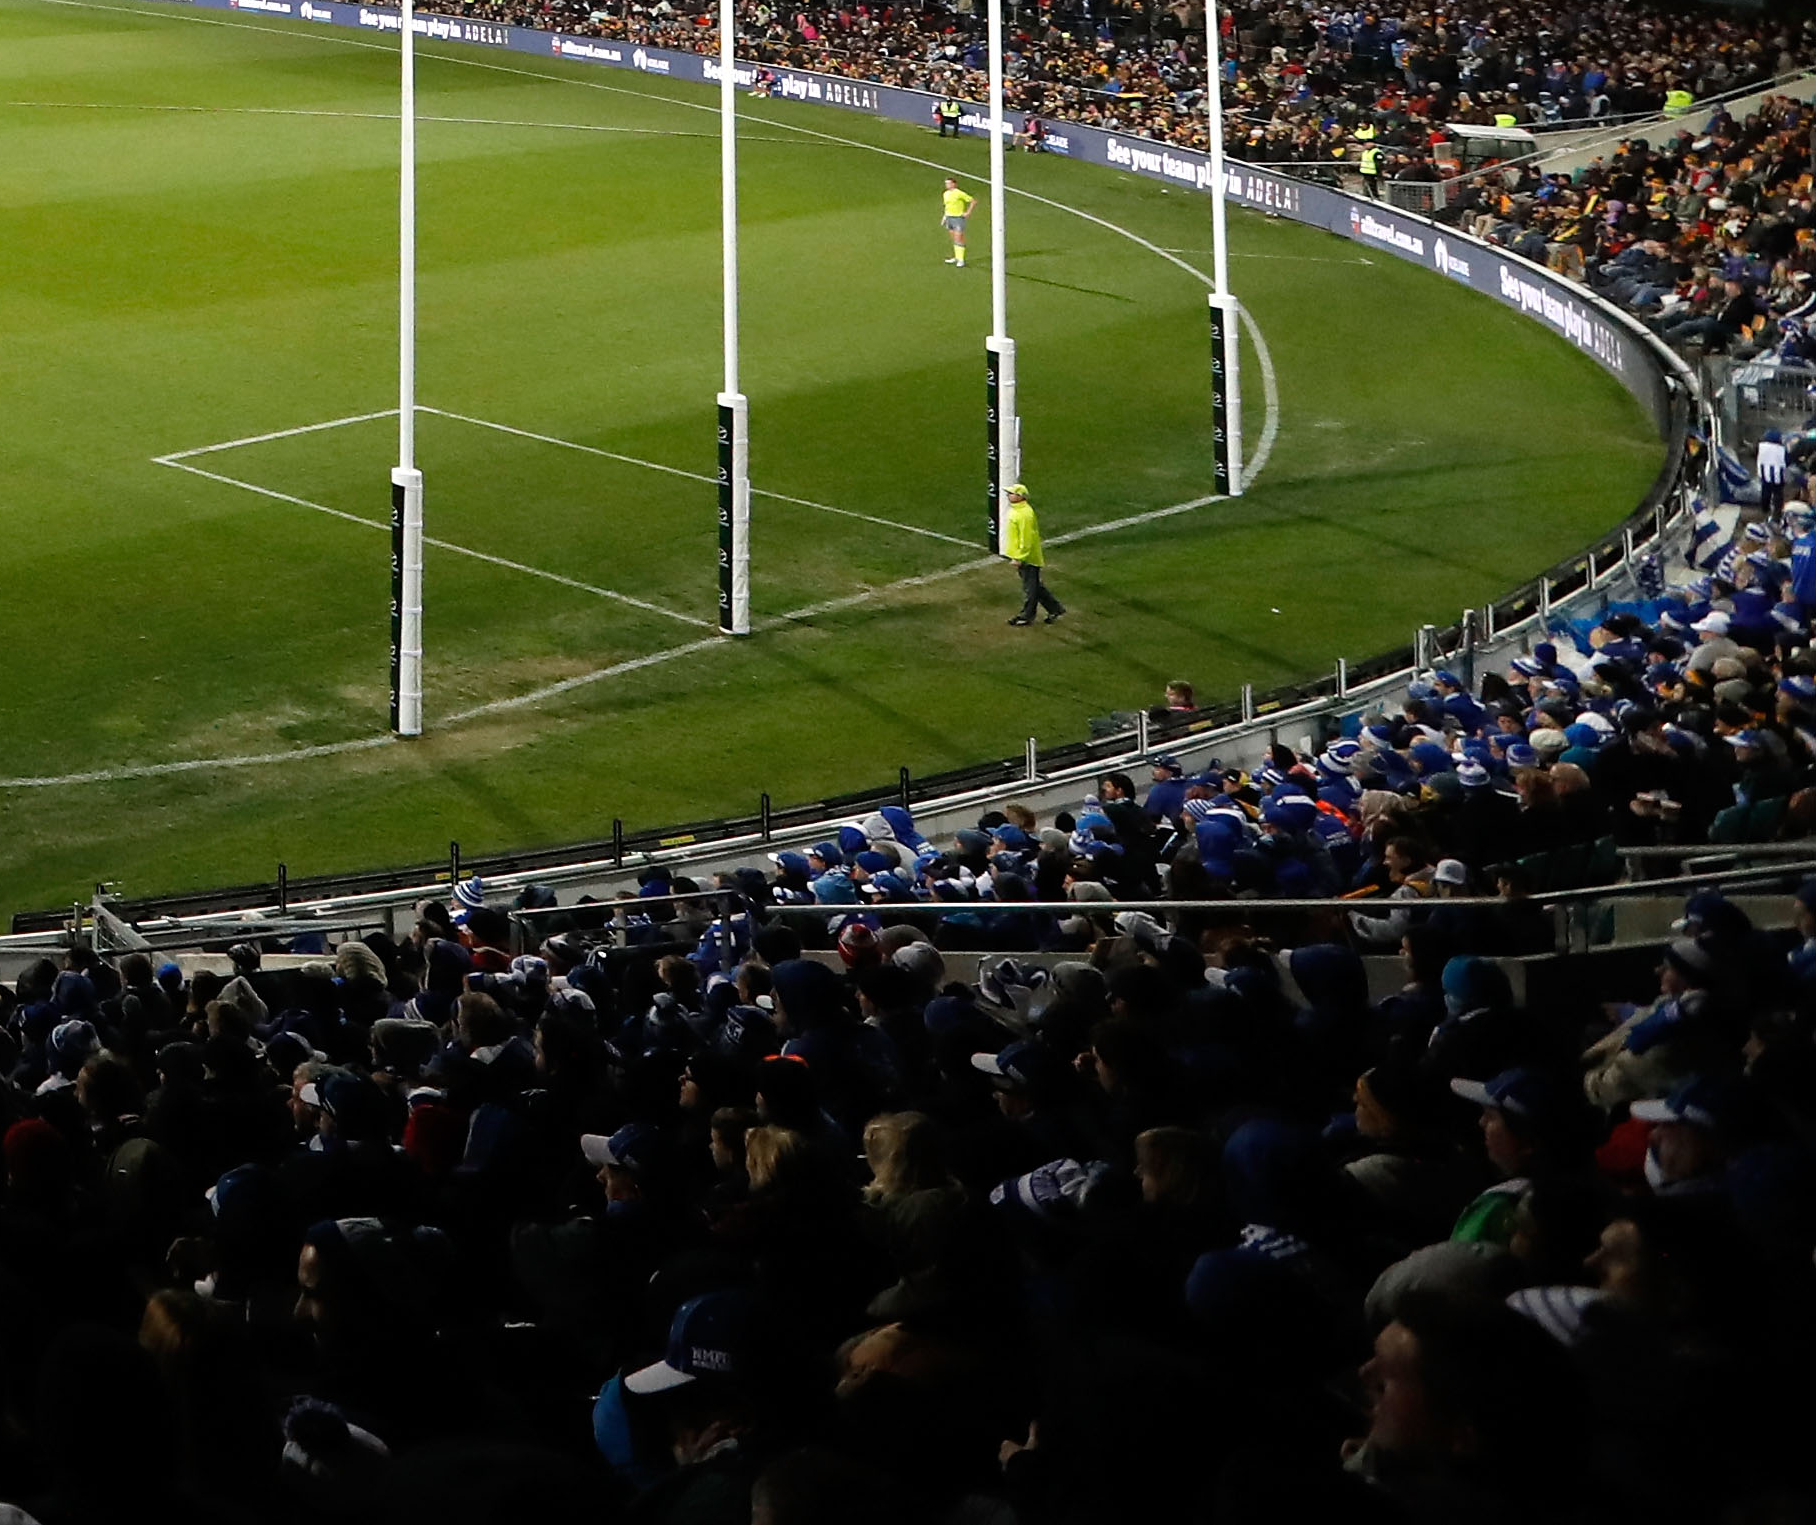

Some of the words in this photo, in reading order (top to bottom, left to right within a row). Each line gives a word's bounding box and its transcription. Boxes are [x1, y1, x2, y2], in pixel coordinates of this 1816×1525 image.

[781, 75, 806, 102] play
[1107, 138, 1131, 166] See
[1131, 148, 1161, 175] your
[1161, 156, 1196, 182] team
